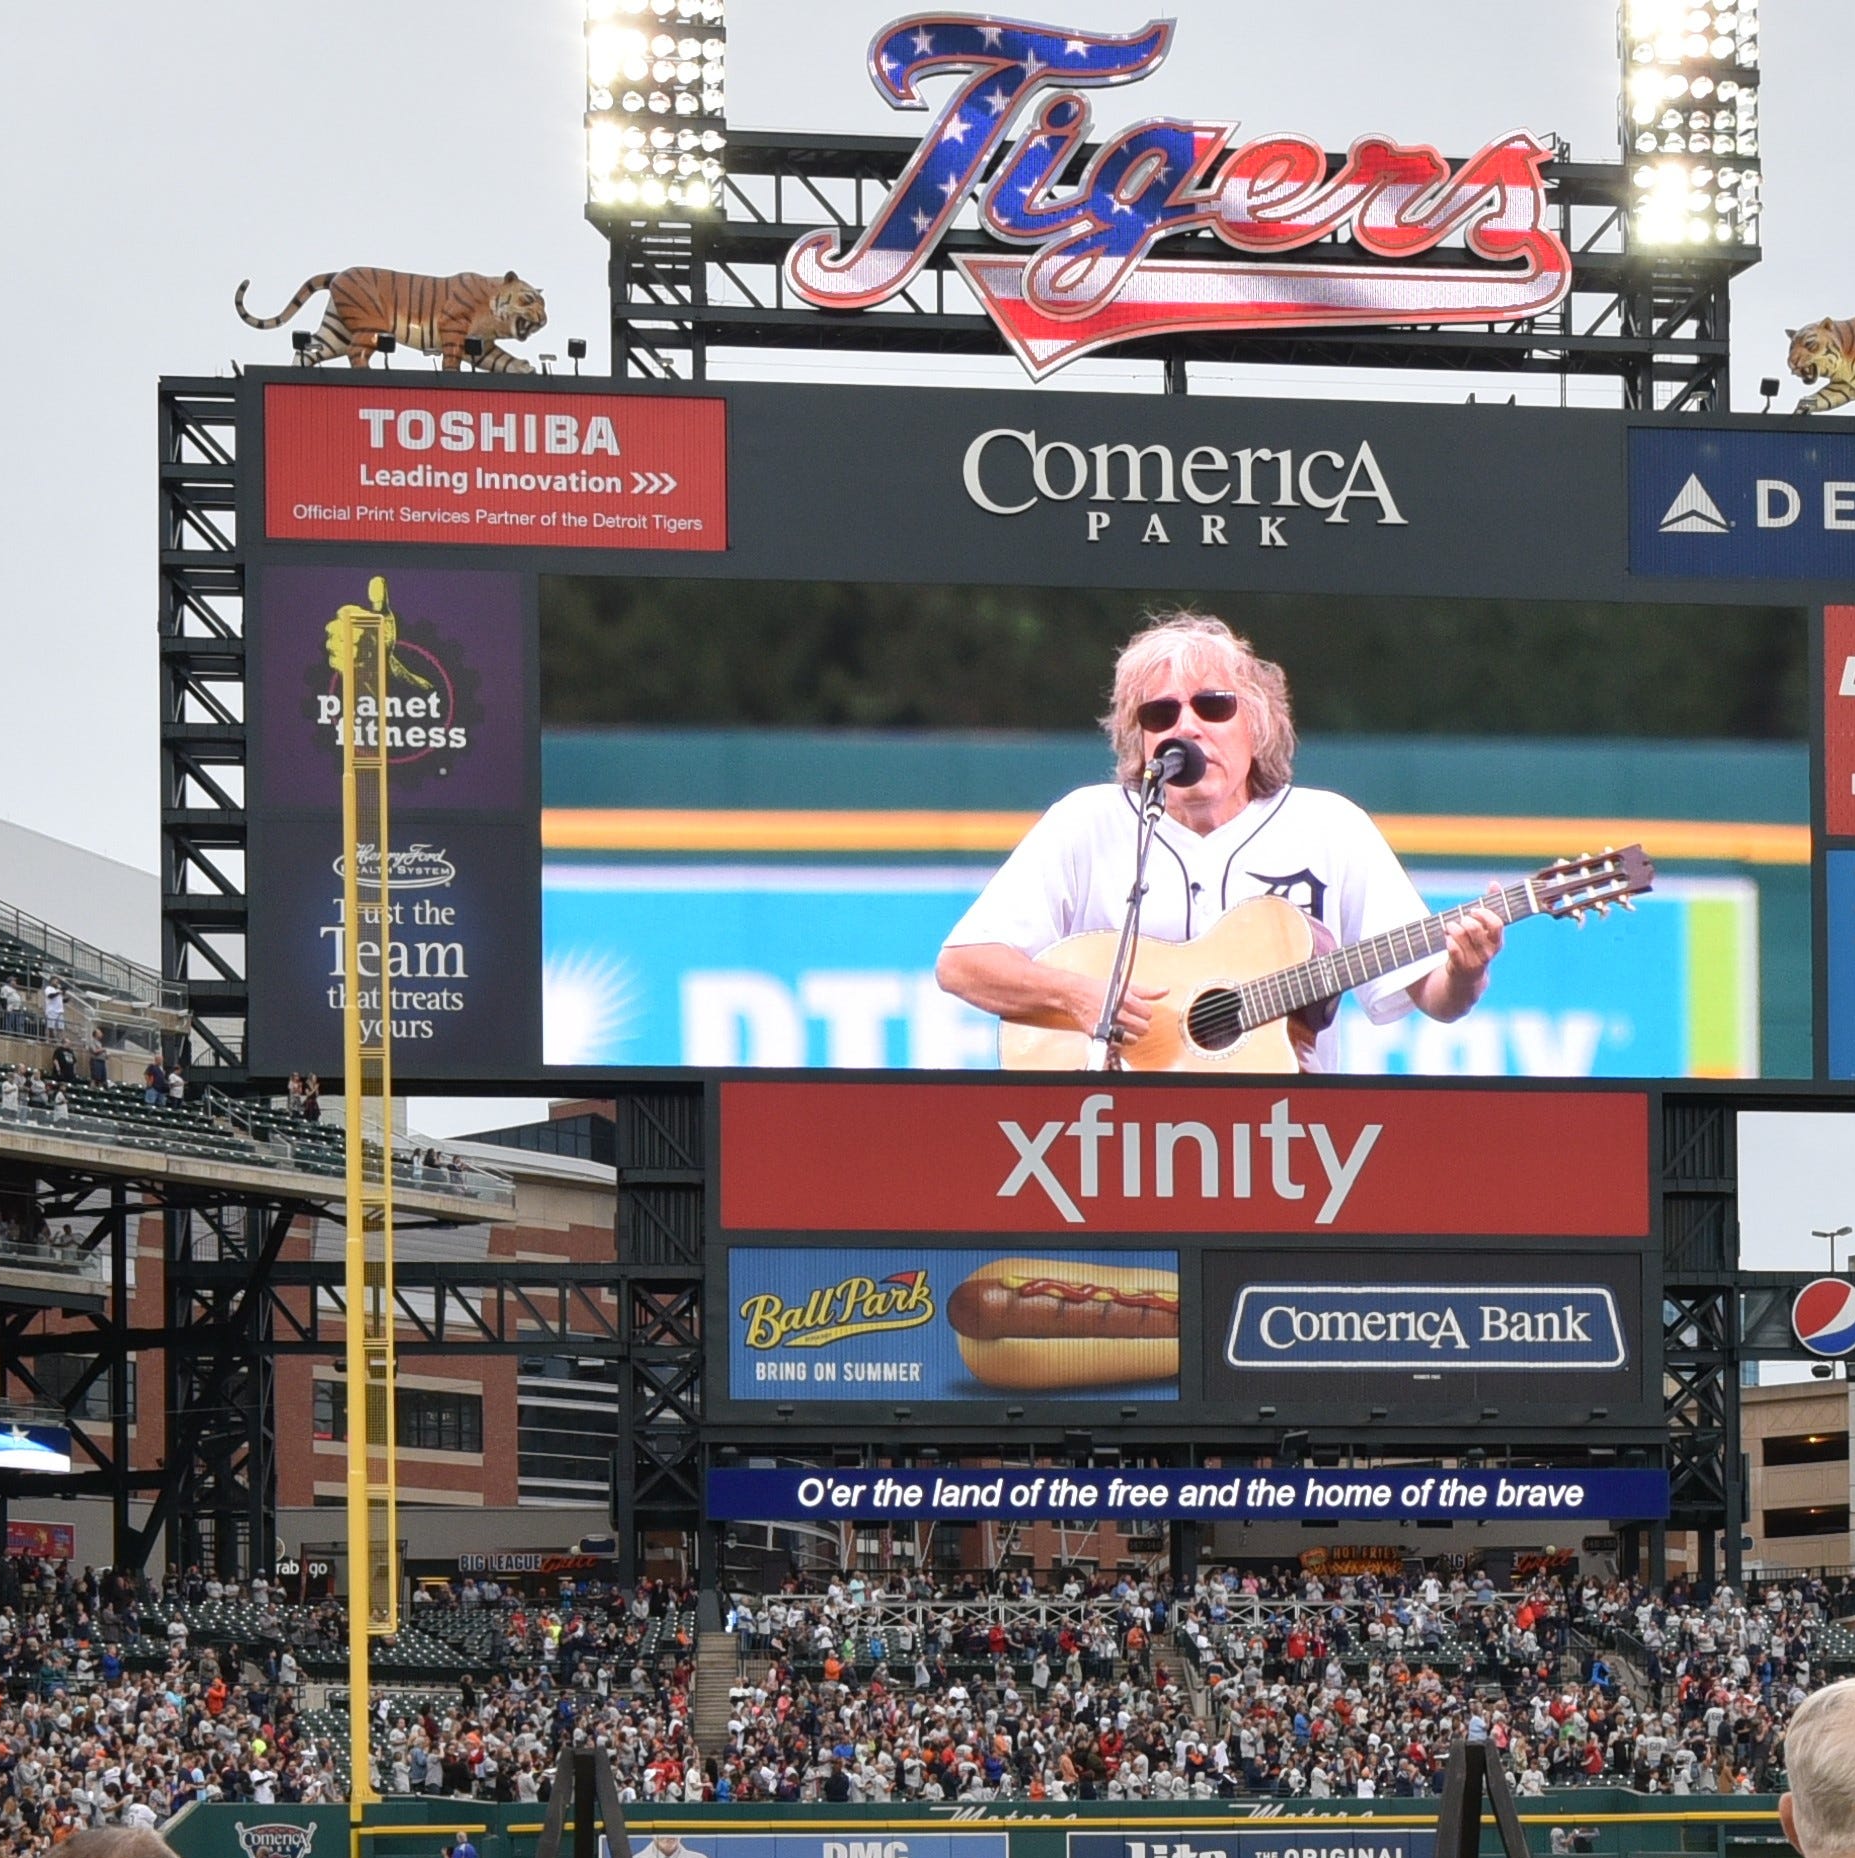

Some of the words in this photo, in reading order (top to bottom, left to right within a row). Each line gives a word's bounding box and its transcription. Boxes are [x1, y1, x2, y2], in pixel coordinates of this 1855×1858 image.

[786, 10, 1572, 340] Tigers
[359, 408, 620, 456] TOSHIBA
[360, 464, 467, 494] Leading
[477, 467, 622, 493] Innovation
[293, 504, 350, 521] Official
[356, 506, 394, 522] Print
[400, 507, 470, 525] Services
[476, 509, 535, 526] Partner
[541, 511, 558, 527] of
[562, 511, 588, 528] the
[593, 513, 648, 529] Detroit
[652, 514, 702, 532] Tigers
[1087, 511, 1288, 547] PARK
[317, 691, 440, 724] panet
[333, 898, 405, 925] Tust
[412, 900, 455, 925] the
[320, 926, 469, 978] Team
[390, 988, 464, 1011] treats
[358, 1019, 434, 1044] yours
[997, 1094, 1384, 1224] xfinity
[740, 1288, 836, 1348] Ball
[835, 1269, 931, 1325] Park
[1480, 1305, 1592, 1342] Bank
[756, 1362, 807, 1381] BRING
[814, 1362, 836, 1381] ON
[844, 1362, 920, 1382] SUMMER
[797, 1477, 866, 1507] O'er
[872, 1477, 923, 1507] the
[932, 1477, 1002, 1507] land
[1009, 1477, 1045, 1507] of
[1048, 1477, 1098, 1507] the
[1107, 1477, 1169, 1507] free
[1178, 1477, 1240, 1507] and
[1246, 1477, 1295, 1507] the
[1305, 1477, 1392, 1507] home
[1401, 1477, 1435, 1507] of
[1438, 1477, 1487, 1507] the
[1496, 1477, 1584, 1507] brave
[276, 1560, 299, 1575] rab
[459, 1554, 483, 1572] BIG
[489, 1554, 542, 1572] LEAGUE
